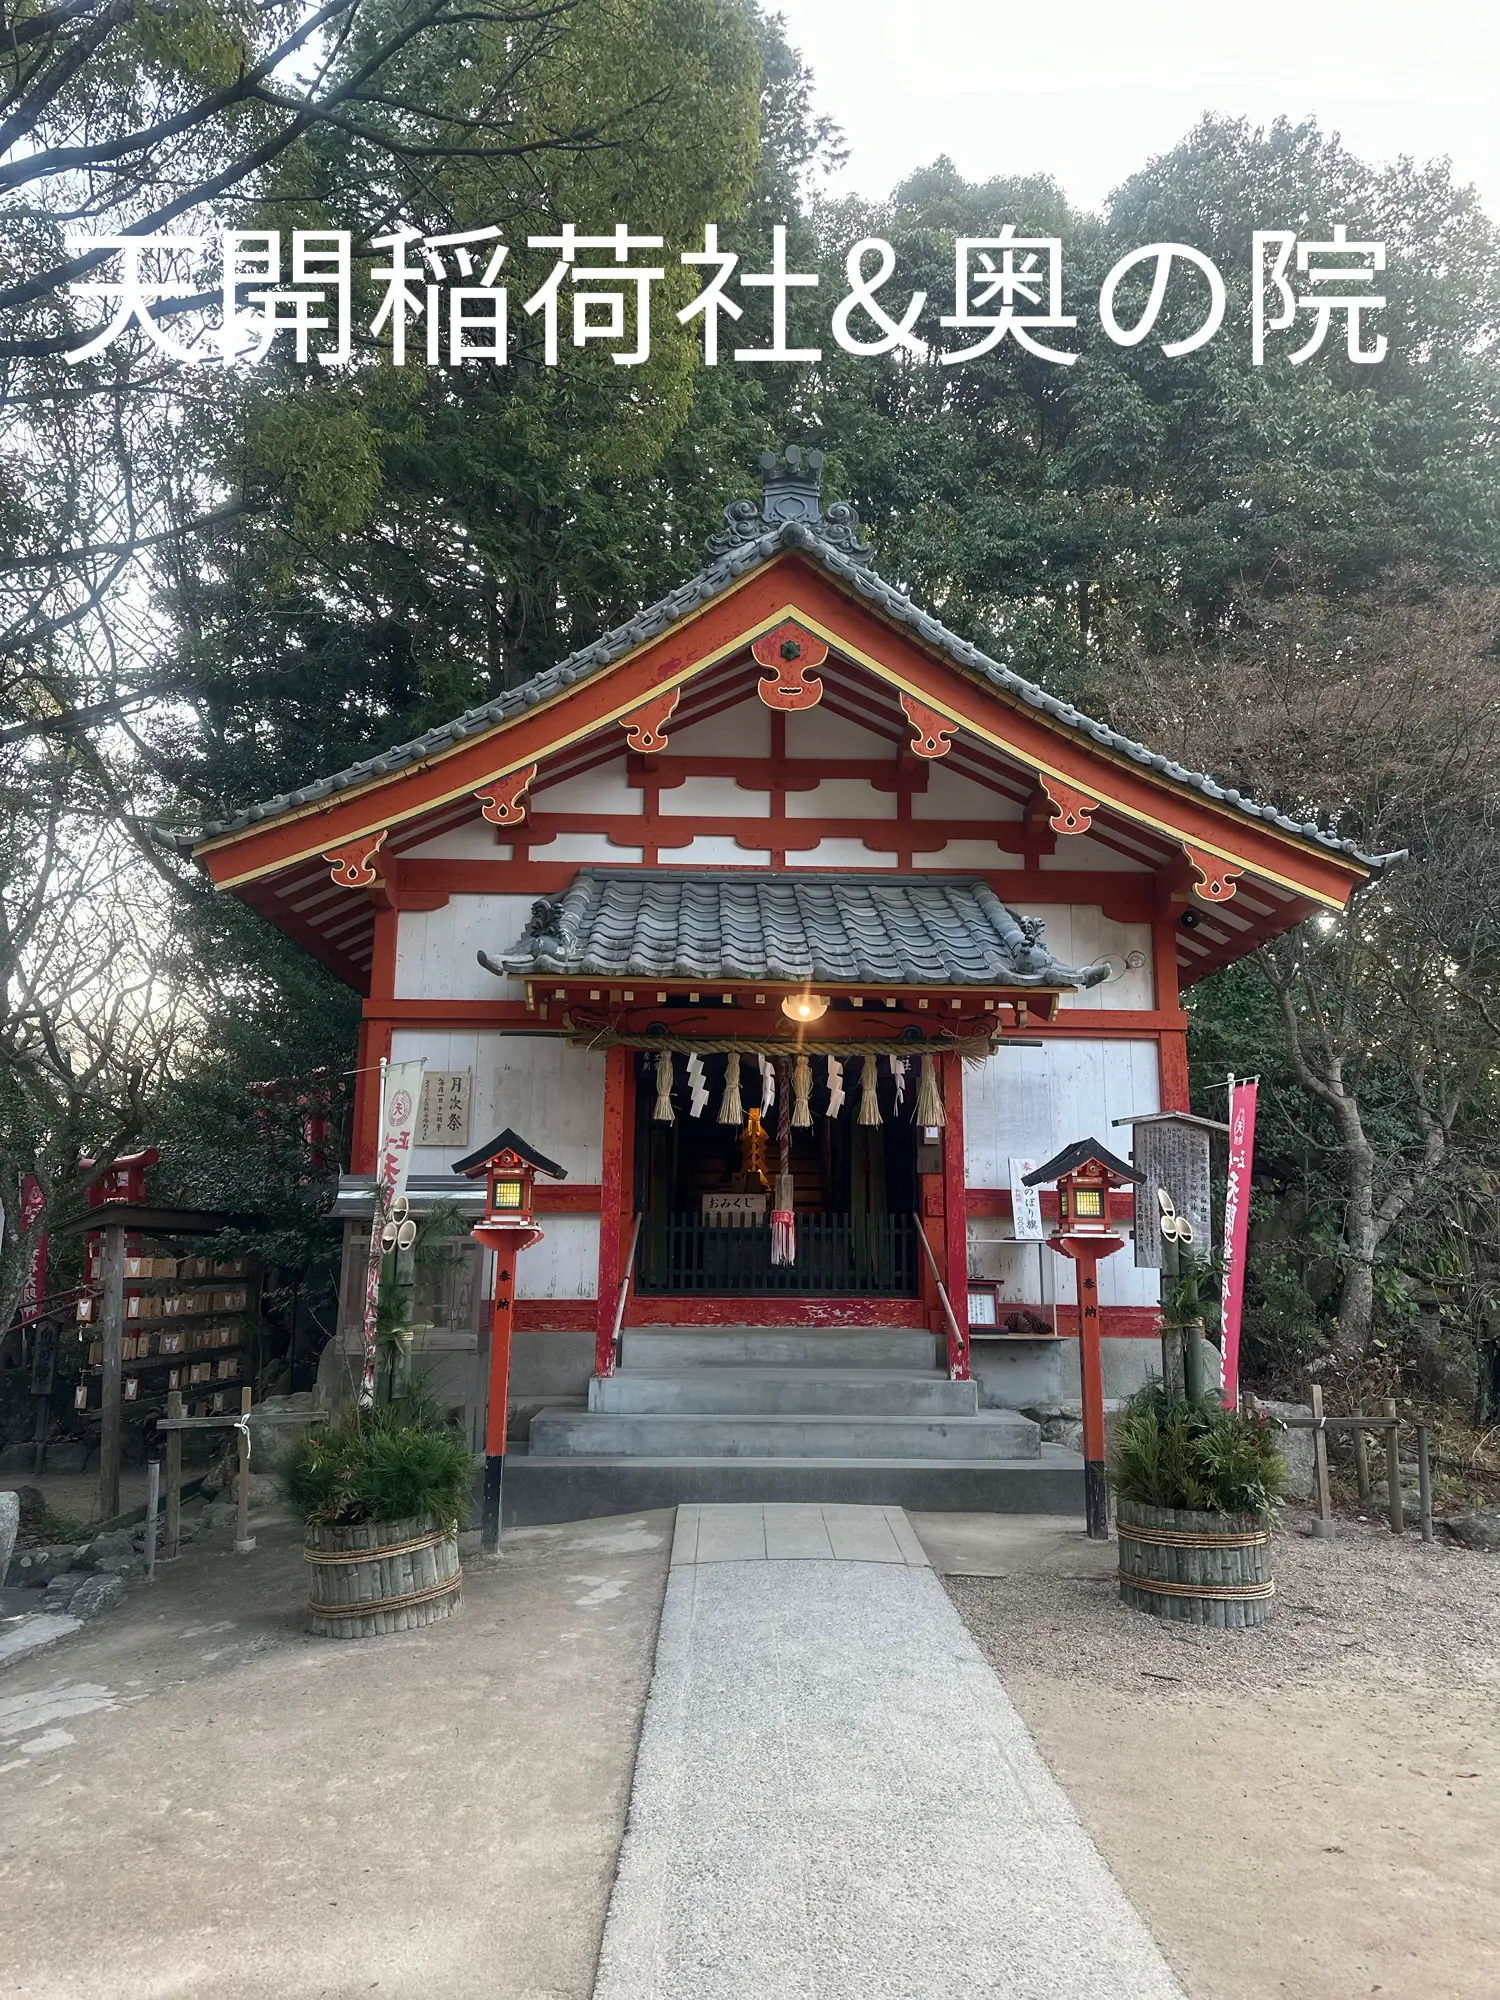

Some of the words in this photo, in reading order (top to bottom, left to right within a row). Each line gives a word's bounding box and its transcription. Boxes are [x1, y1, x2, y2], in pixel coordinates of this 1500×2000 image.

[447, 1077, 462, 1131] 月次祭
[709, 1197, 755, 1209] おみくじ
[498, 1268, 511, 1312] 奉納
[1083, 1276, 1096, 1319] 奉納
